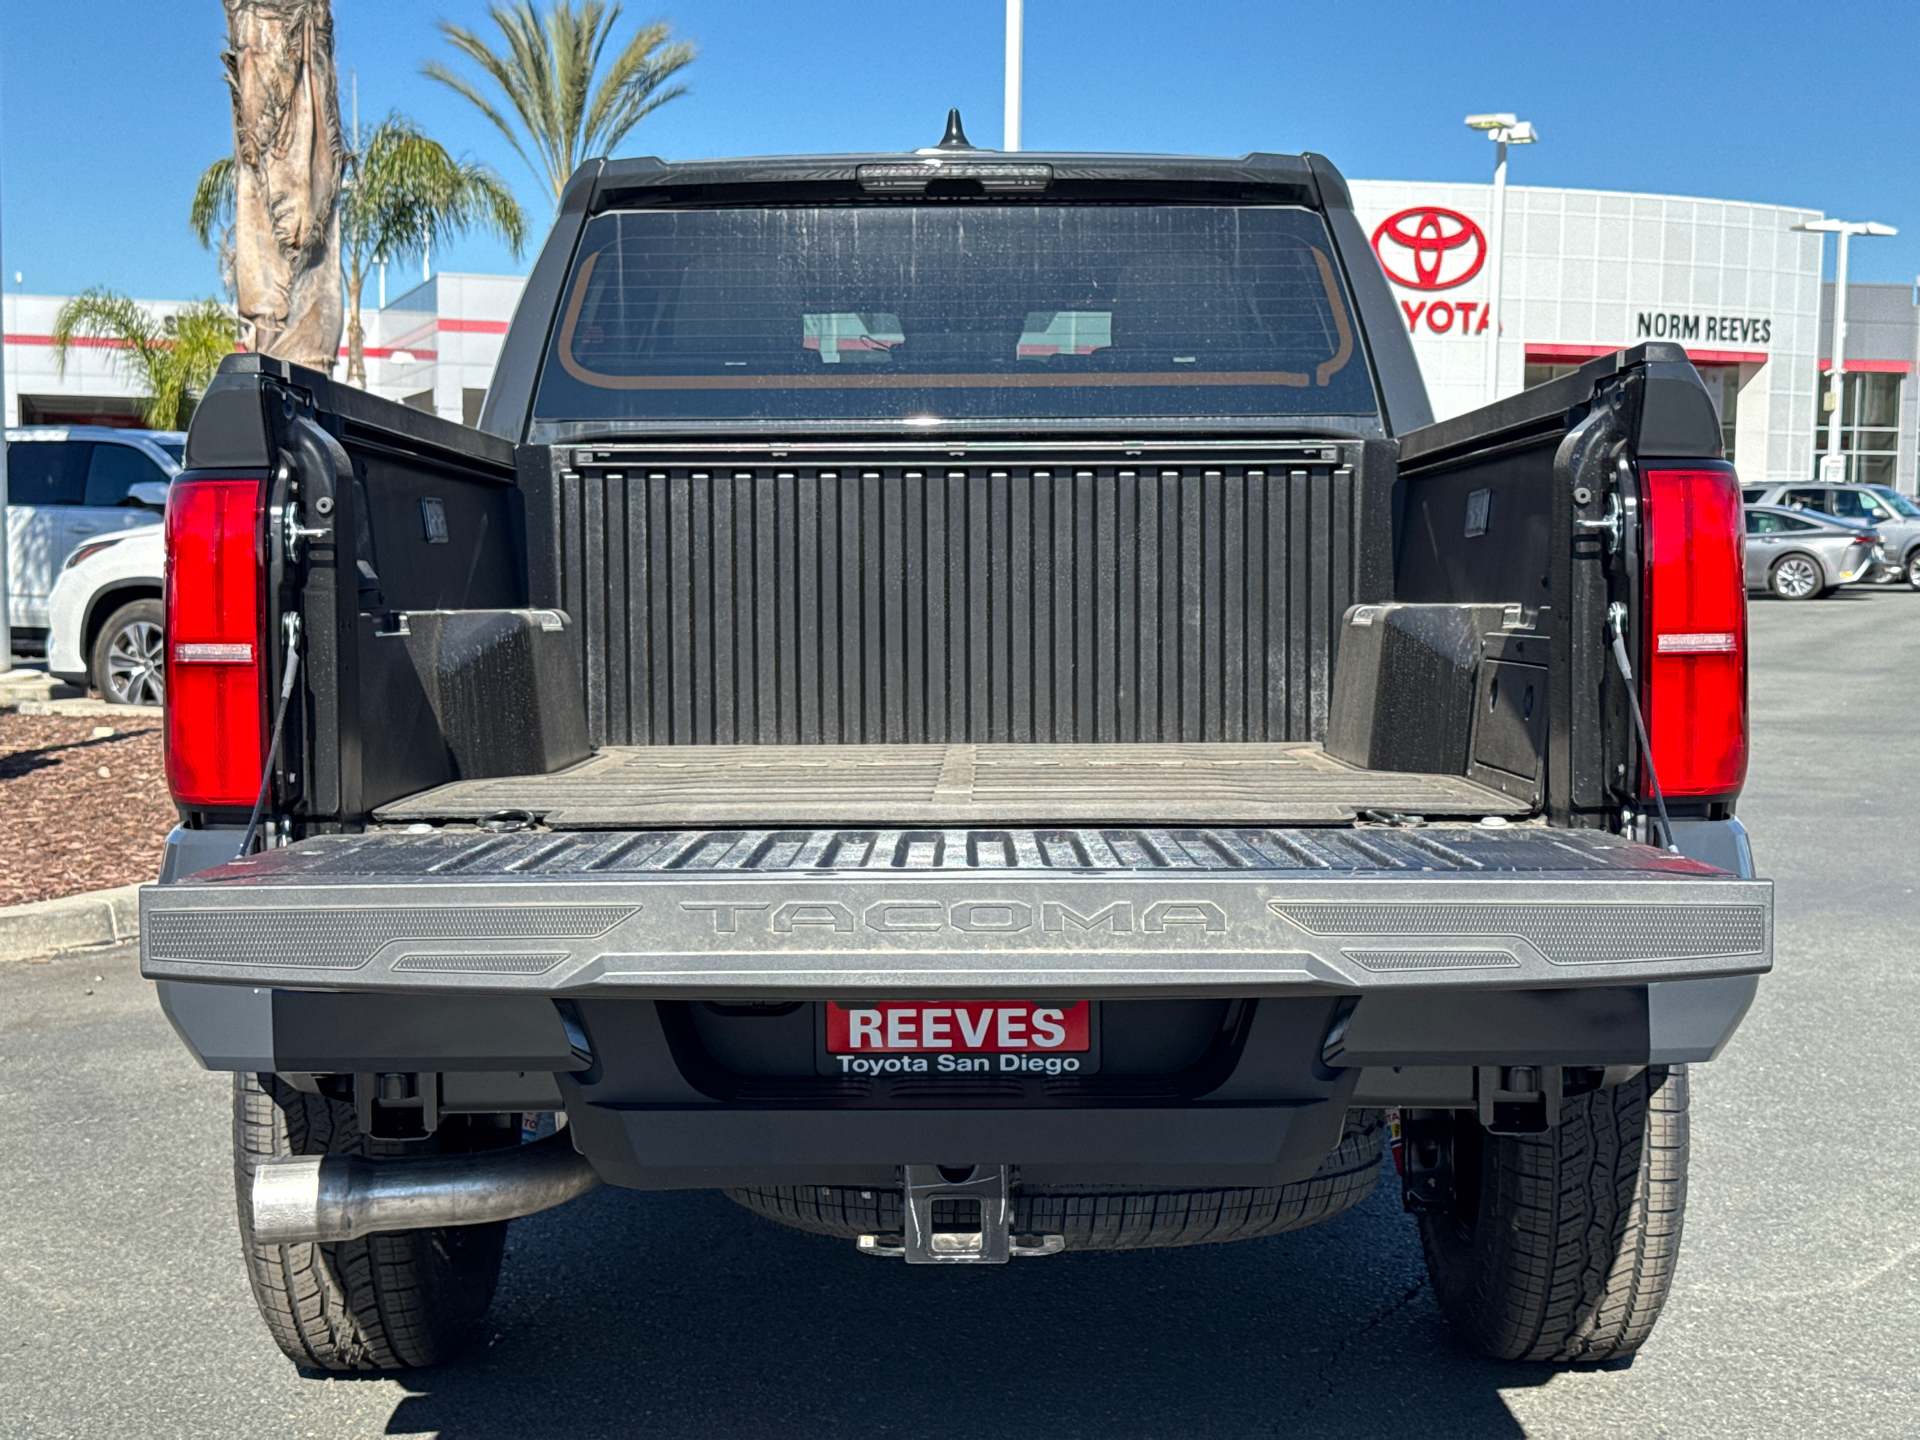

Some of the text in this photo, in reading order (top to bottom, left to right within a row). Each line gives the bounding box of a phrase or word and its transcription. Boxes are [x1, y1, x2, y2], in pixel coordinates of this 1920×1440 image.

[1400, 300, 1503, 336] YOTA
[1636, 311, 1771, 343] NORM REEVES
[680, 900, 1227, 932] TACOMA
[849, 1008, 1066, 1048] REEVES
[836, 1054, 1080, 1076] Toyota San Diego
